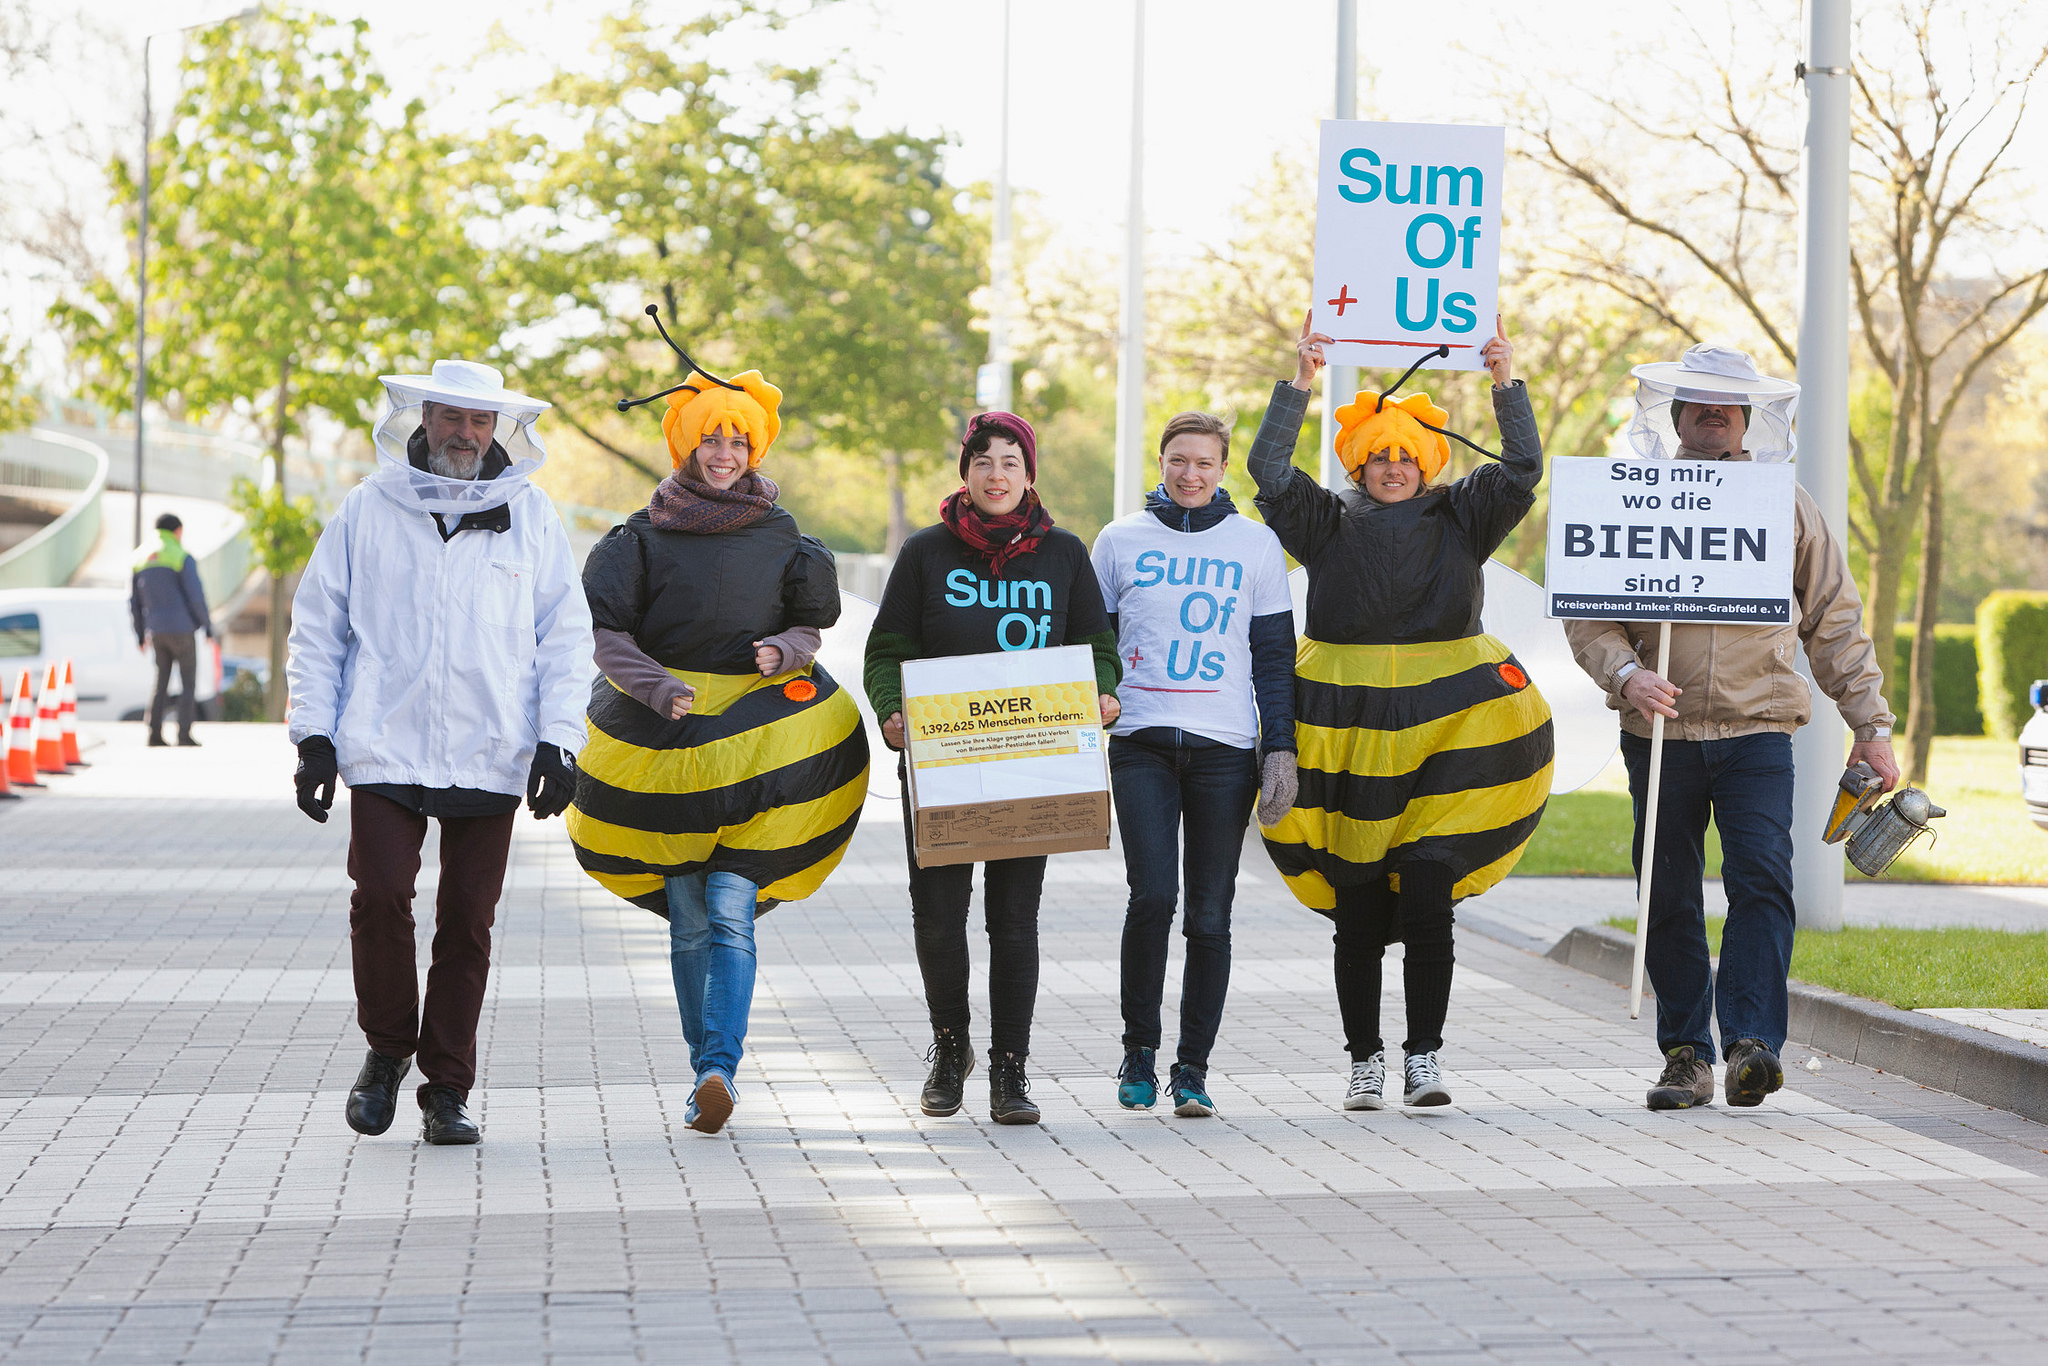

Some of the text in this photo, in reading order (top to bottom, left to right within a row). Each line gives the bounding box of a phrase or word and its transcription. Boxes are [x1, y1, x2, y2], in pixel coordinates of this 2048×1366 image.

[1337, 147, 1484, 207] Sum
[1405, 212, 1482, 269] Of
[1395, 276, 1477, 334] Us
[1610, 462, 1724, 487] Sag mir,
[1622, 491, 1712, 511] wo die
[1564, 523, 1767, 562] BIENEN
[944, 568, 1052, 610] Sum
[1133, 550, 1243, 591] Sum
[1624, 573, 1705, 593] sind ?
[1179, 591, 1237, 635] Of
[1556, 600, 1786, 615] Kreisverband Imker Rhön-Grabfeld e. V.
[996, 612, 1052, 652] Of
[1166, 640, 1226, 682] Us
[921, 711, 1084, 736] 1,392,625 Menschen fordern:
[969, 697, 1032, 717] BAYER
